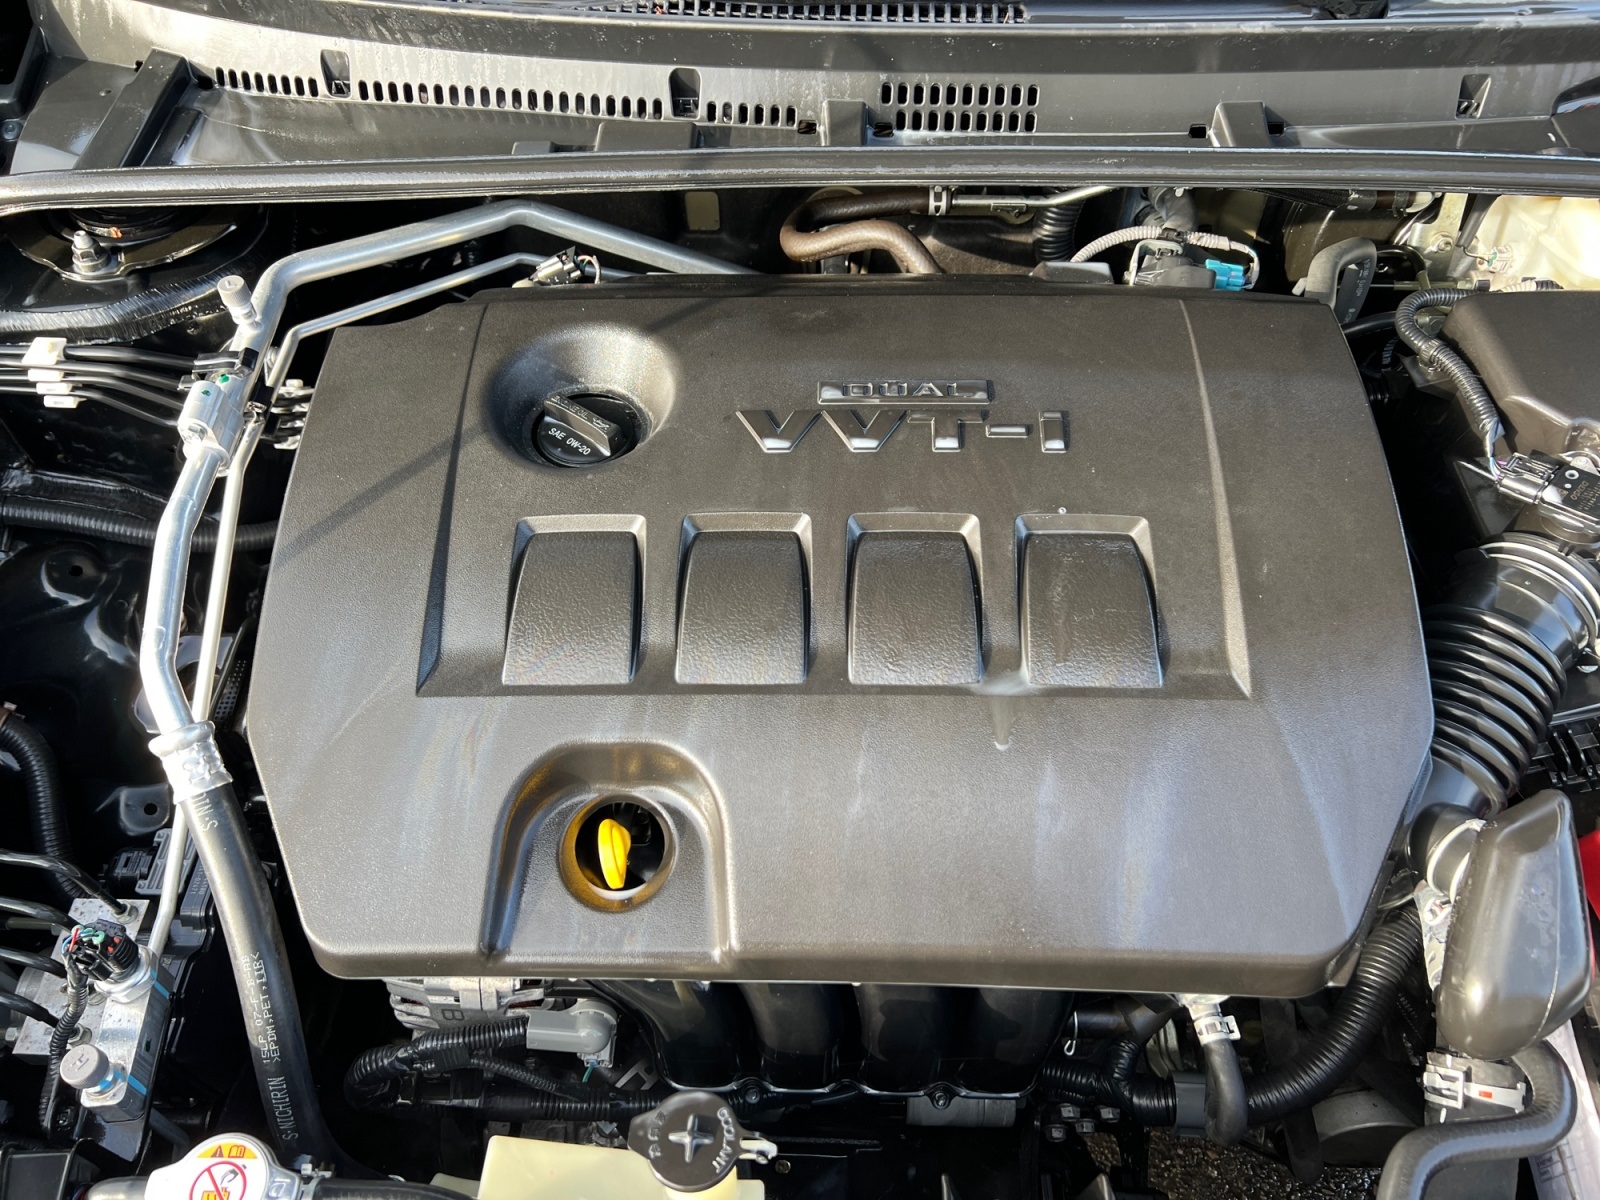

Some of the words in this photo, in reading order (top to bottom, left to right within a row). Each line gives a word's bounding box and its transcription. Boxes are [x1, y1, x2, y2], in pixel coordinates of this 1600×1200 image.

[842, 380, 974, 397] DUAL
[548, 427, 566, 440] SAE
[566, 437, 591, 456] 0W-20
[735, 409, 1067, 453] VVT-i
[712, 1107, 735, 1174] COOLANT
